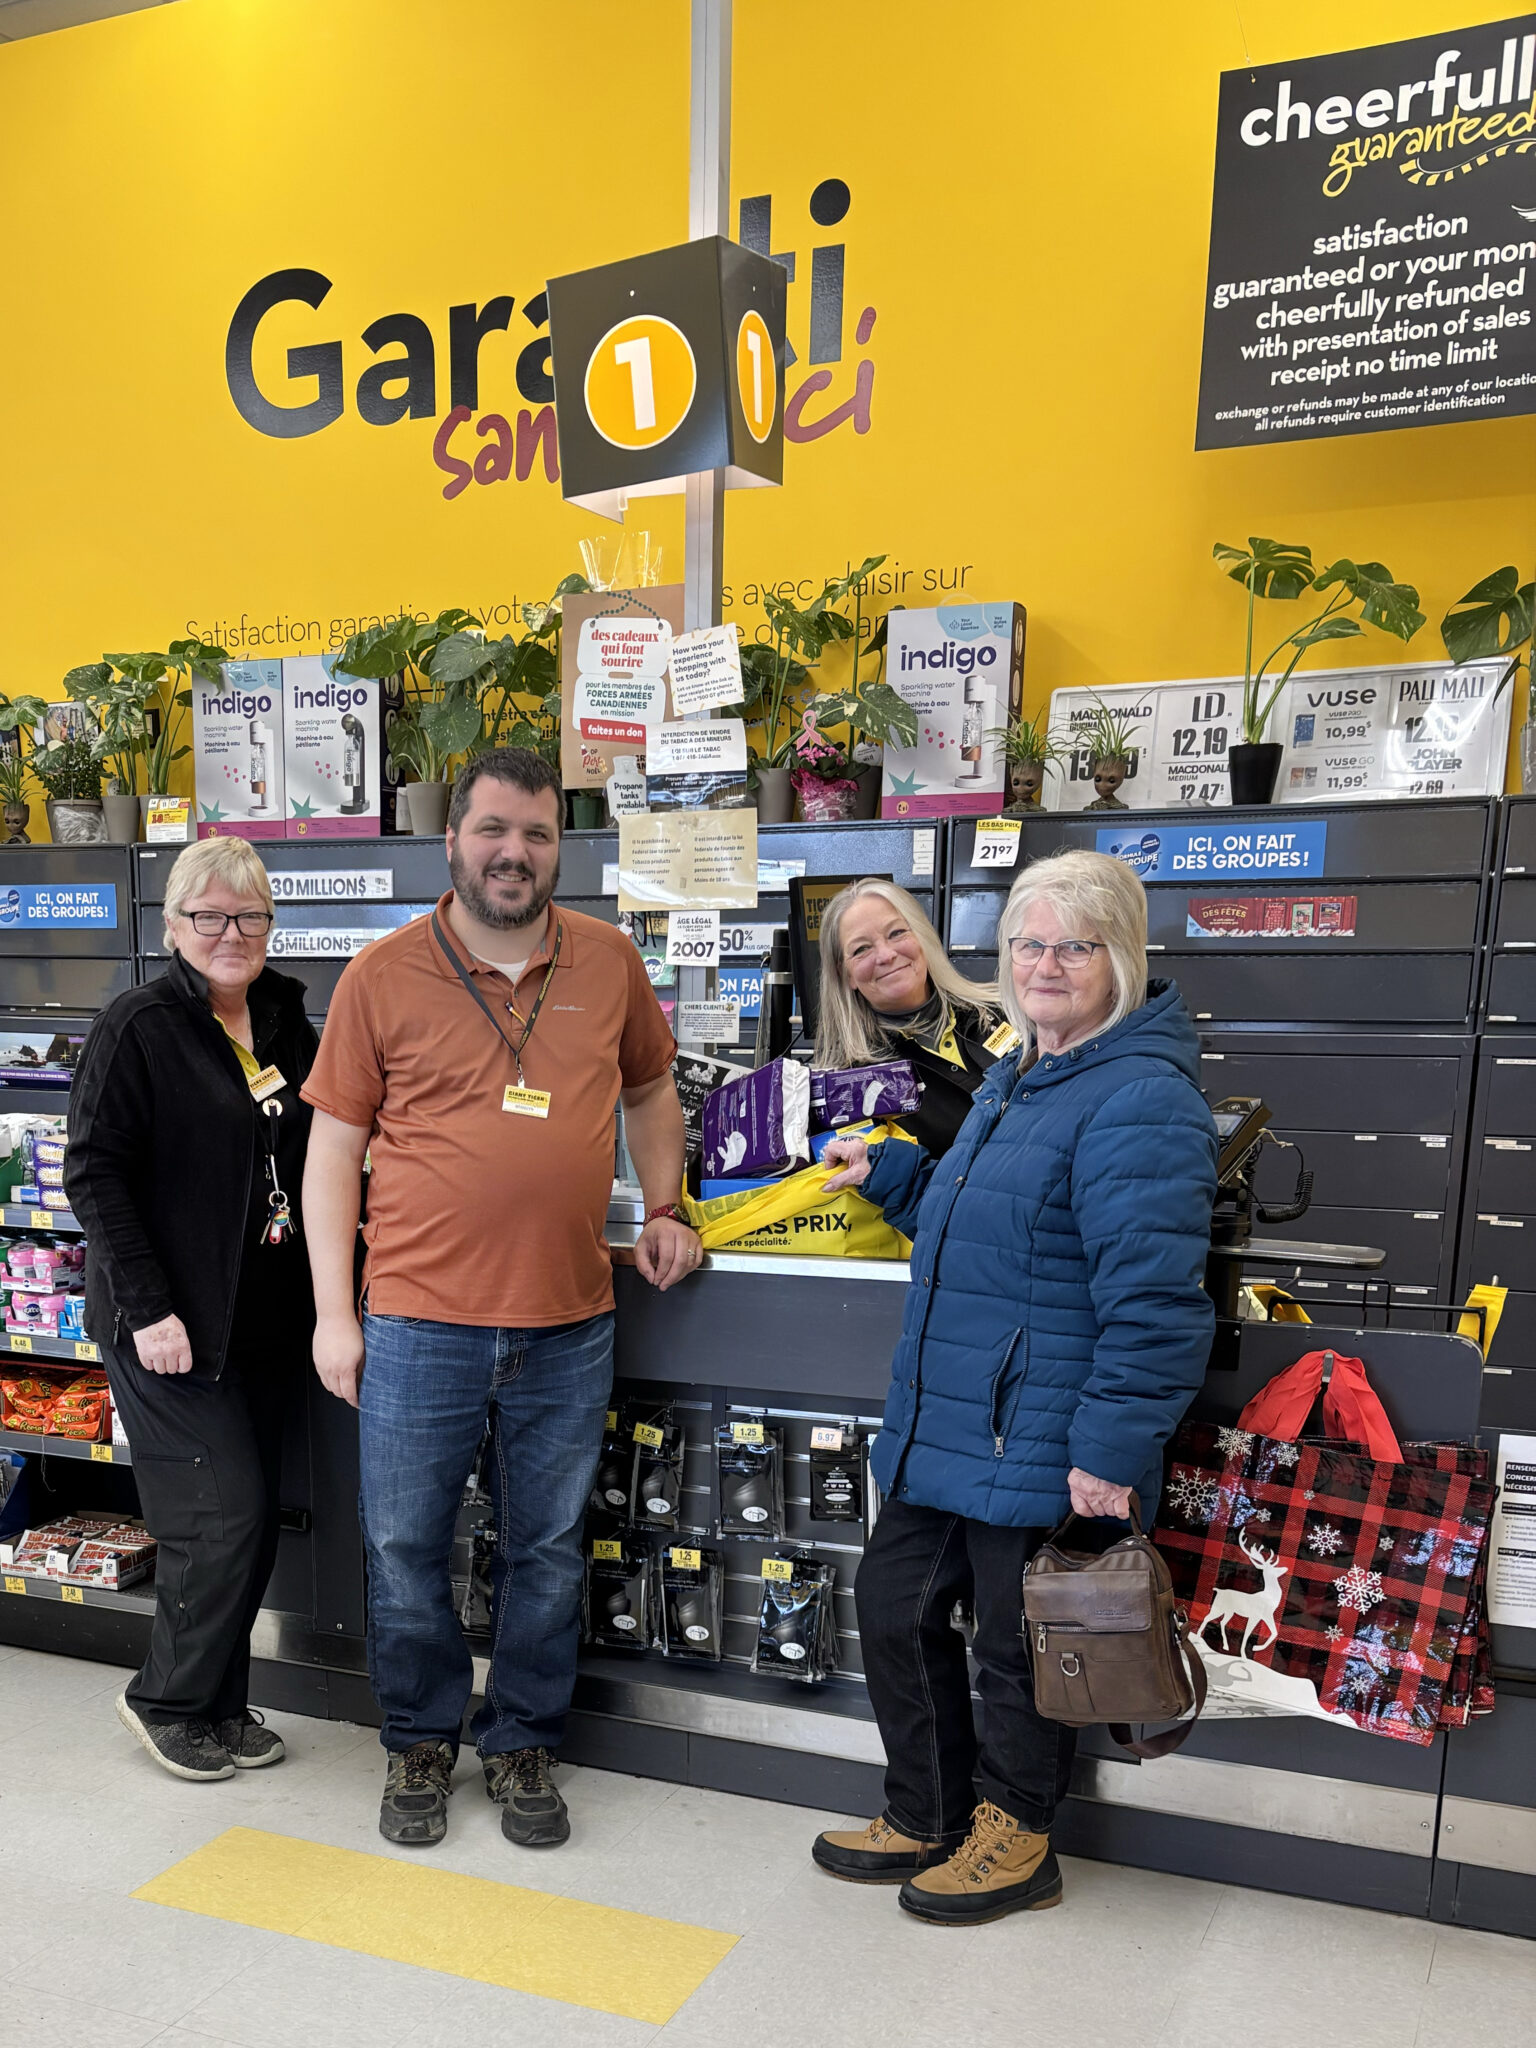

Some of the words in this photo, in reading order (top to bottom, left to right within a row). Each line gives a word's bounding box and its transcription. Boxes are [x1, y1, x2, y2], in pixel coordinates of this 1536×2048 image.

[1322, 90, 1536, 198] guaranteed
[1313, 213, 1469, 255] satisfaction
[1213, 256, 1365, 309] guaranteed
[1370, 263, 1400, 282] or
[1405, 250, 1468, 285] your
[1256, 289, 1390, 330] cheerfully
[1395, 268, 1526, 313] refunded
[1241, 333, 1288, 361] with
[1292, 319, 1438, 361] presentation
[1443, 310, 1470, 336] of
[1473, 305, 1531, 332] sales
[1270, 357, 1350, 387] receipt
[1355, 361, 1384, 376] no
[1389, 349, 1442, 374] time
[1447, 338, 1498, 365] limit
[616, 337, 656, 430] 1
[747, 330, 763, 425] 1
[1215, 406, 1268, 422] exchange
[1272, 403, 1285, 414] or
[1287, 396, 1332, 412] refunds
[1335, 398, 1360, 409] may
[1362, 393, 1378, 405] be
[1380, 388, 1413, 403] made
[1416, 388, 1429, 398] at
[1431, 386, 1453, 398] any
[1456, 382, 1470, 393] of
[1471, 381, 1493, 392] our
[1255, 419, 1268, 430] all
[1271, 413, 1316, 429] refunds
[1319, 409, 1362, 424] require
[1364, 404, 1421, 418] customer
[1424, 393, 1505, 412] identification
[744, 580, 813, 606] avec
[923, 564, 974, 591] sur
[186, 614, 321, 649] Satisfaction
[591, 629, 607, 641] des
[612, 630, 660, 642] cadeaux
[601, 643, 619, 656] qui
[621, 642, 645, 656] font
[672, 647, 689, 656] How
[691, 643, 707, 653] was
[708, 639, 725, 649] your
[601, 656, 644, 668] sourire
[674, 651, 713, 665] experience
[901, 641, 997, 675] indigo
[675, 662, 708, 675] shopping
[709, 657, 727, 666] with
[686, 669, 711, 681] today?
[901, 682, 933, 691] Sparkling
[934, 681, 956, 689] water
[1399, 680, 1438, 703] PALL
[294, 683, 368, 713] indigo
[587, 690, 618, 699] FORCES
[619, 690, 653, 700] ARMÉES
[901, 690, 931, 698] machine
[202, 690, 272, 720] indigo
[590, 700, 648, 710] CANADIENNES
[1071, 706, 1152, 721] MACDONALD
[588, 725, 613, 736] faites
[614, 727, 625, 736] un
[626, 727, 643, 738] don
[661, 731, 700, 741] INTERDICTION
[709, 729, 731, 737] VENDRE
[670, 737, 688, 745] TABAC
[1173, 727, 1228, 758] 12,19
[1168, 762, 1232, 775] MACDONAL
[1168, 774, 1198, 783] MEDIUM
[614, 782, 643, 791] Propane
[620, 792, 640, 800] tanks
[616, 802, 645, 810] available
[1188, 836, 1217, 857] ICI,
[1222, 836, 1251, 852] ON
[1256, 834, 1296, 851] FAIT
[1172, 855, 1208, 870] DES
[271, 877, 294, 896] 30
[36, 892, 54, 907] ICI,
[56, 892, 73, 905] ON
[76, 892, 99, 905] FAIT
[28, 906, 49, 919] DES
[1203, 909, 1220, 919] DES
[1221, 907, 1248, 919] FÊTES
[691, 916, 713, 925] LÉGAL
[672, 941, 715, 959] 2007
[741, 978, 764, 992] FAI
[676, 1079, 692, 1094] Toy
[794, 1212, 852, 1236] PRIX,
[641, 1428, 656, 1439] 1.25
[739, 1427, 757, 1437] 1.25
[600, 1543, 613, 1552] 1.25
[679, 1550, 692, 1561] 1.25
[767, 1563, 784, 1573] 1.25
